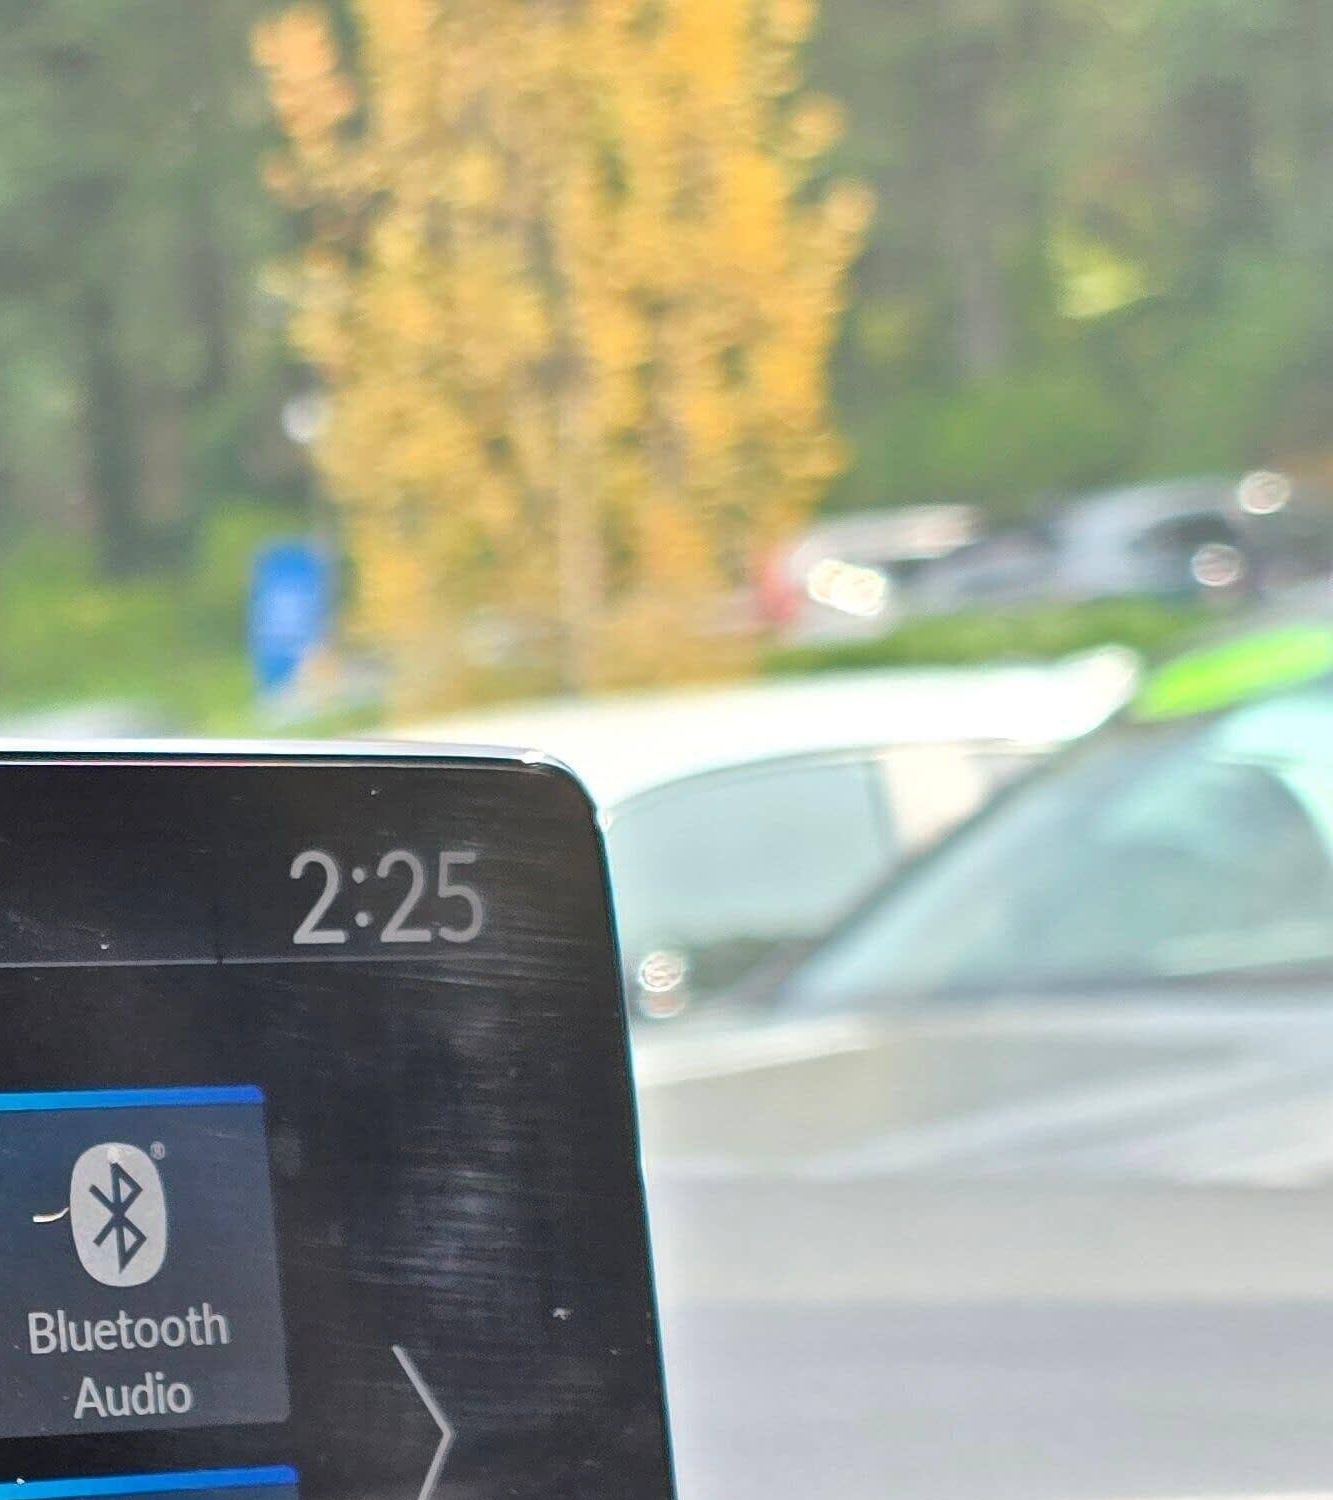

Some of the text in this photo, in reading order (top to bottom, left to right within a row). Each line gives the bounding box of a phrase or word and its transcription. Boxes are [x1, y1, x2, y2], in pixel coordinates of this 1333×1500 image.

[290, 848, 485, 945] 2:25
[27, 1302, 230, 1355] Bluetooth
[73, 1371, 193, 1420] Audio
